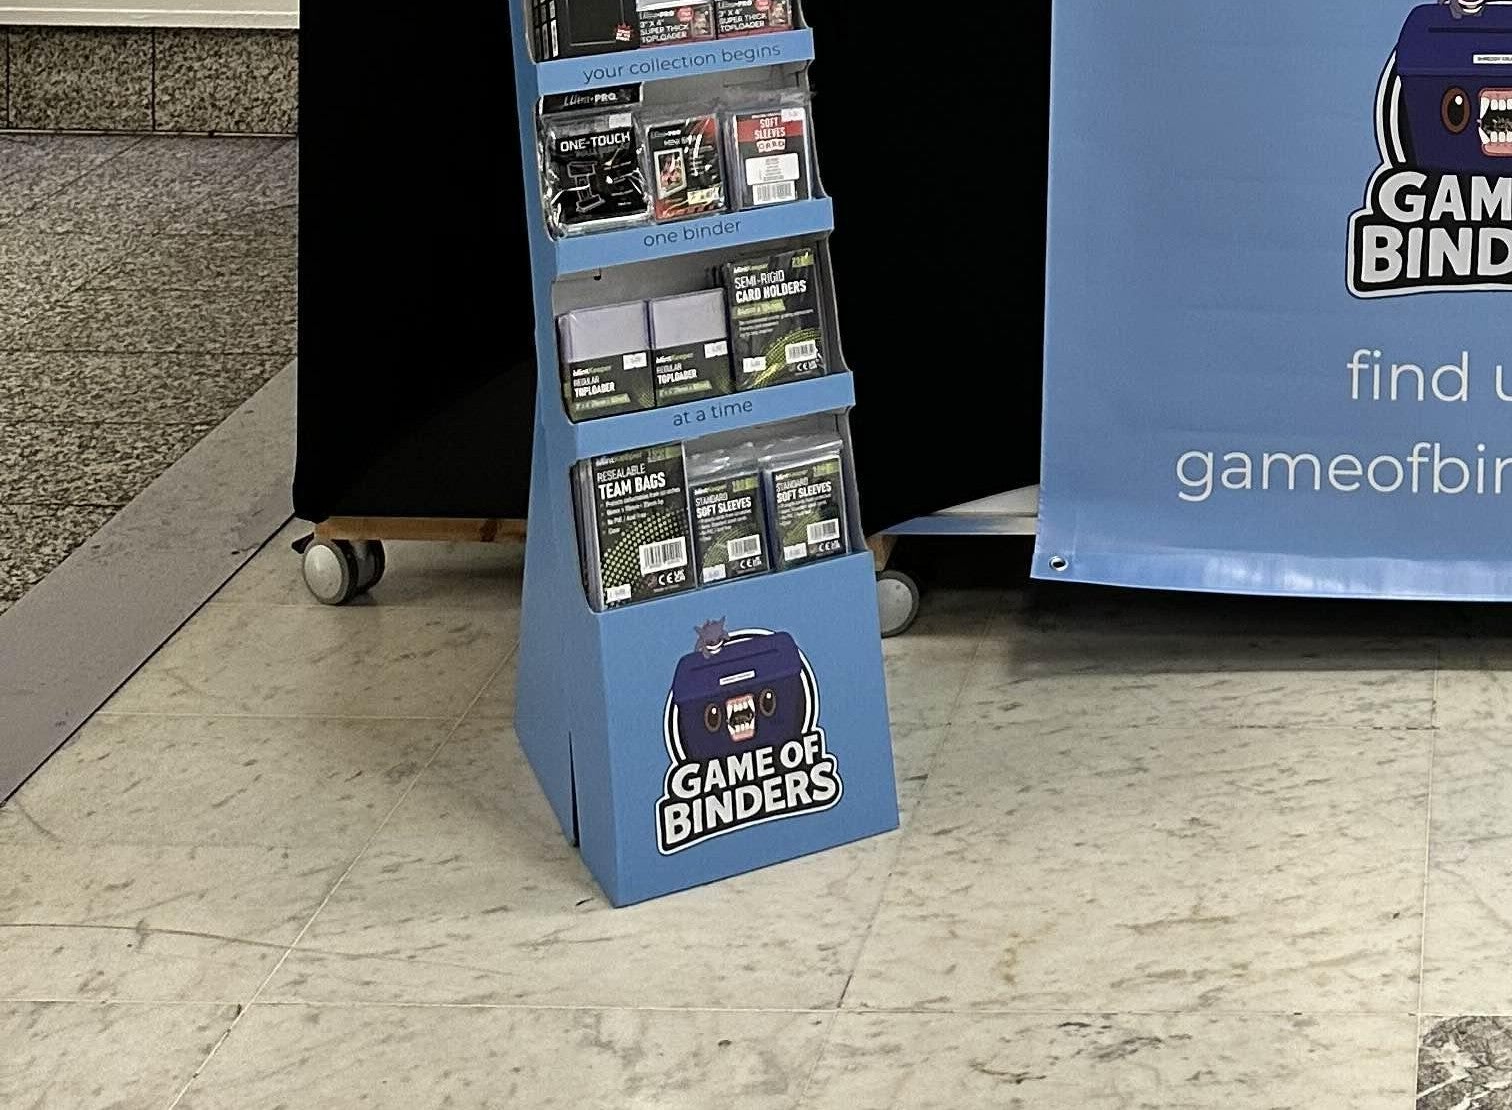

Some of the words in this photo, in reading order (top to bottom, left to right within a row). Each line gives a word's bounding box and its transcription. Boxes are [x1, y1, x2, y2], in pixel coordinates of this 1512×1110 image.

[584, 64, 624, 82] your
[629, 53, 716, 75] collection
[721, 42, 781, 63] begins
[754, 126, 786, 140] SLEEVES
[759, 118, 780, 129] SOFT
[560, 132, 630, 152] ONE-TOUCH
[643, 230, 678, 248] one
[682, 219, 742, 242] binder
[734, 270, 785, 290] SEMI-RIGID
[736, 288, 762, 304] CARD
[764, 280, 807, 299] HOLDERS
[656, 369, 698, 384] TOPLOADER
[1347, 350, 1469, 402] find
[574, 382, 616, 398] TOPLOADER
[672, 410, 692, 427] at
[696, 410, 706, 422] a
[710, 398, 753, 420] time
[596, 463, 646, 483] RESEALABLE
[598, 478, 632, 500] TEAM
[634, 472, 666, 493] BAGS
[798, 481, 832, 498] SLEEVES
[696, 505, 717, 518] SOFT
[718, 496, 752, 514] SLEEVES
[672, 746, 774, 800] GAME
[780, 734, 820, 769] OF
[664, 762, 837, 845] BINDERS
